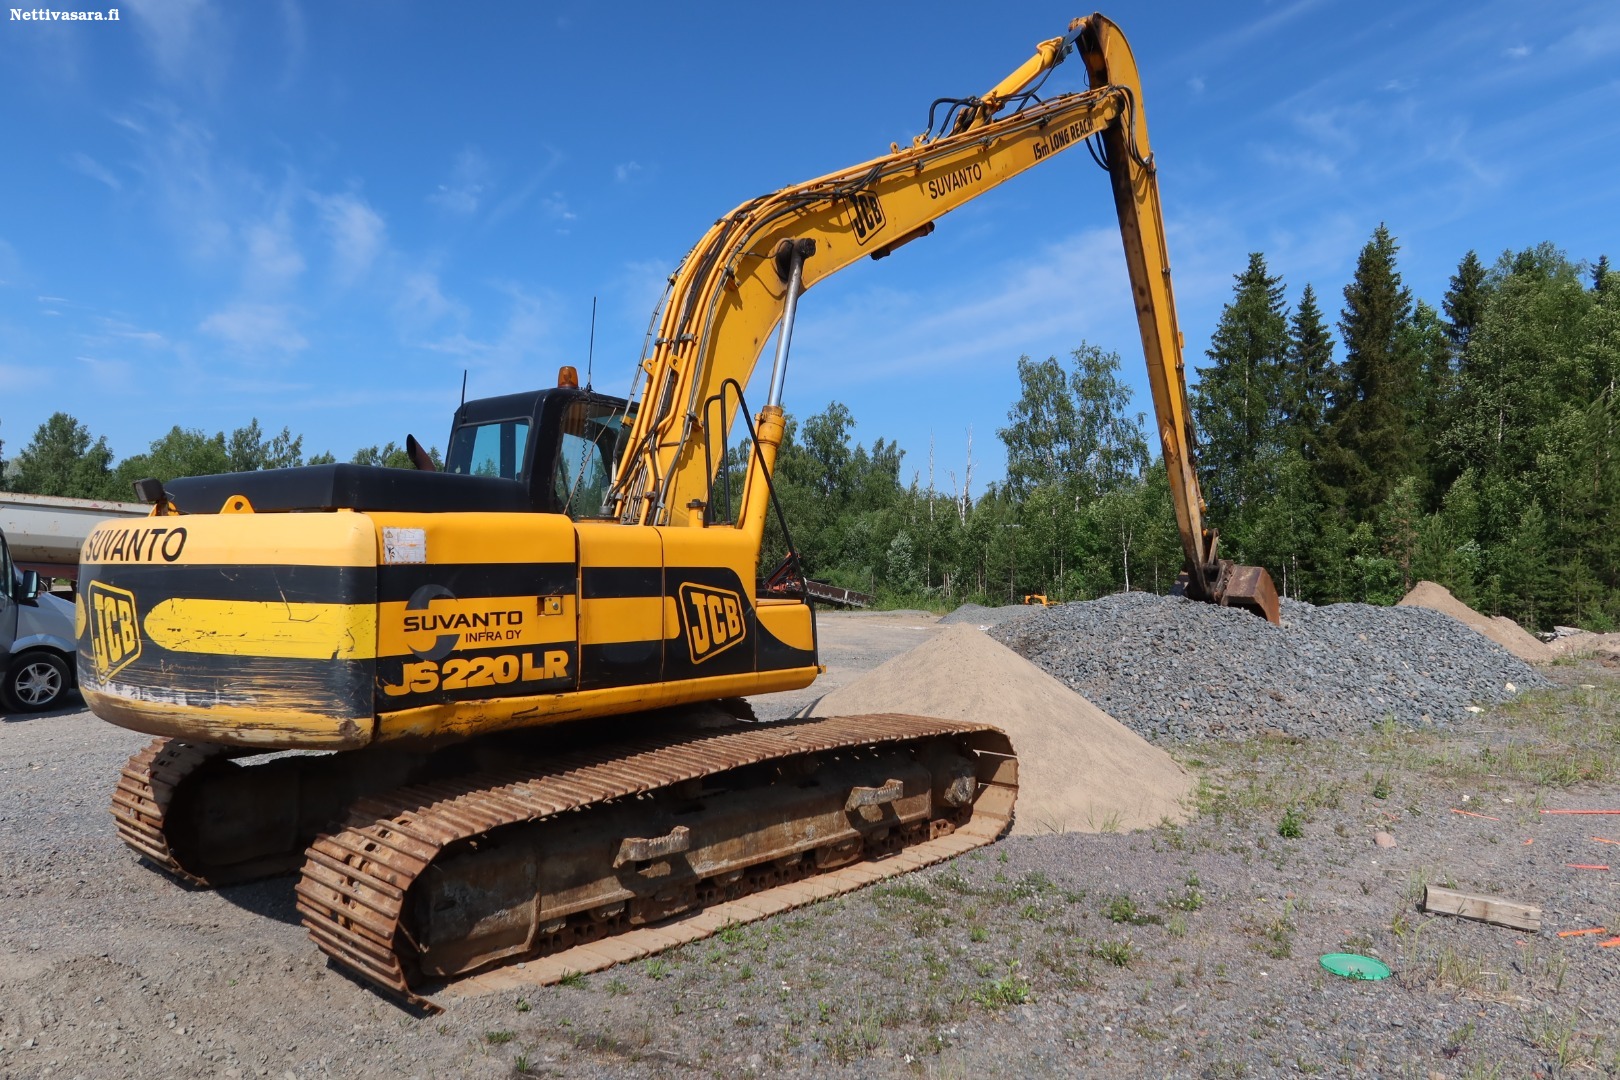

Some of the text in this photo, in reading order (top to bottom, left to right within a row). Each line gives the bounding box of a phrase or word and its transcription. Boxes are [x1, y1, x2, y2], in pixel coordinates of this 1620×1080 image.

[1033, 117, 1095, 161] 15m LONG REACH
[928, 163, 982, 199] SUVANTO
[849, 193, 883, 239] JCB
[85, 527, 188, 562] SUVANTO
[94, 593, 138, 672] JCB
[403, 610, 523, 632] SUVANTO
[465, 629, 522, 643] INFRA OY
[691, 592, 741, 653] JCB
[384, 650, 569, 697] JS220LR
